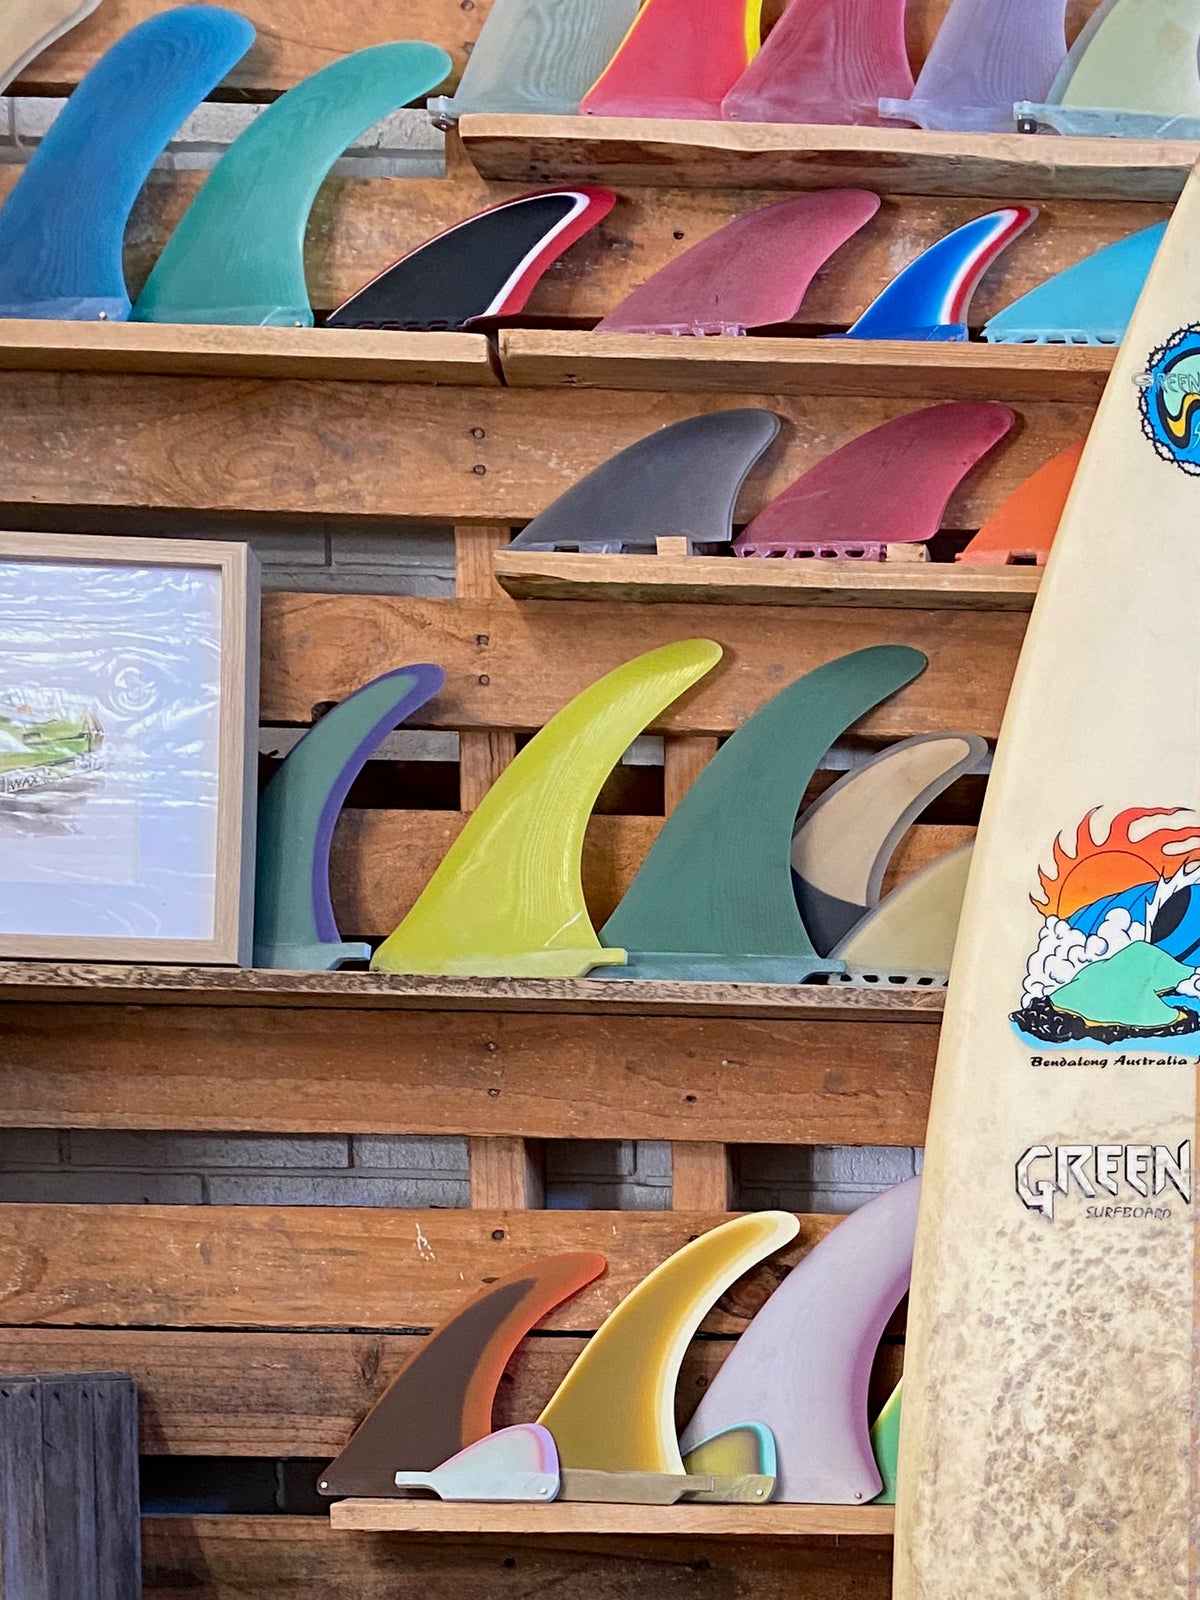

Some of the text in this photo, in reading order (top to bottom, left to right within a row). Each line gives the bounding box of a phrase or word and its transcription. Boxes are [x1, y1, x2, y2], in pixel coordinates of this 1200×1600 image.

[1030, 1056, 1109, 1069] Bendalong
[1113, 1054, 1188, 1066] Australia
[1015, 1138, 1192, 1224] GREEN
[1085, 1205, 1172, 1221] SURFBOARD
